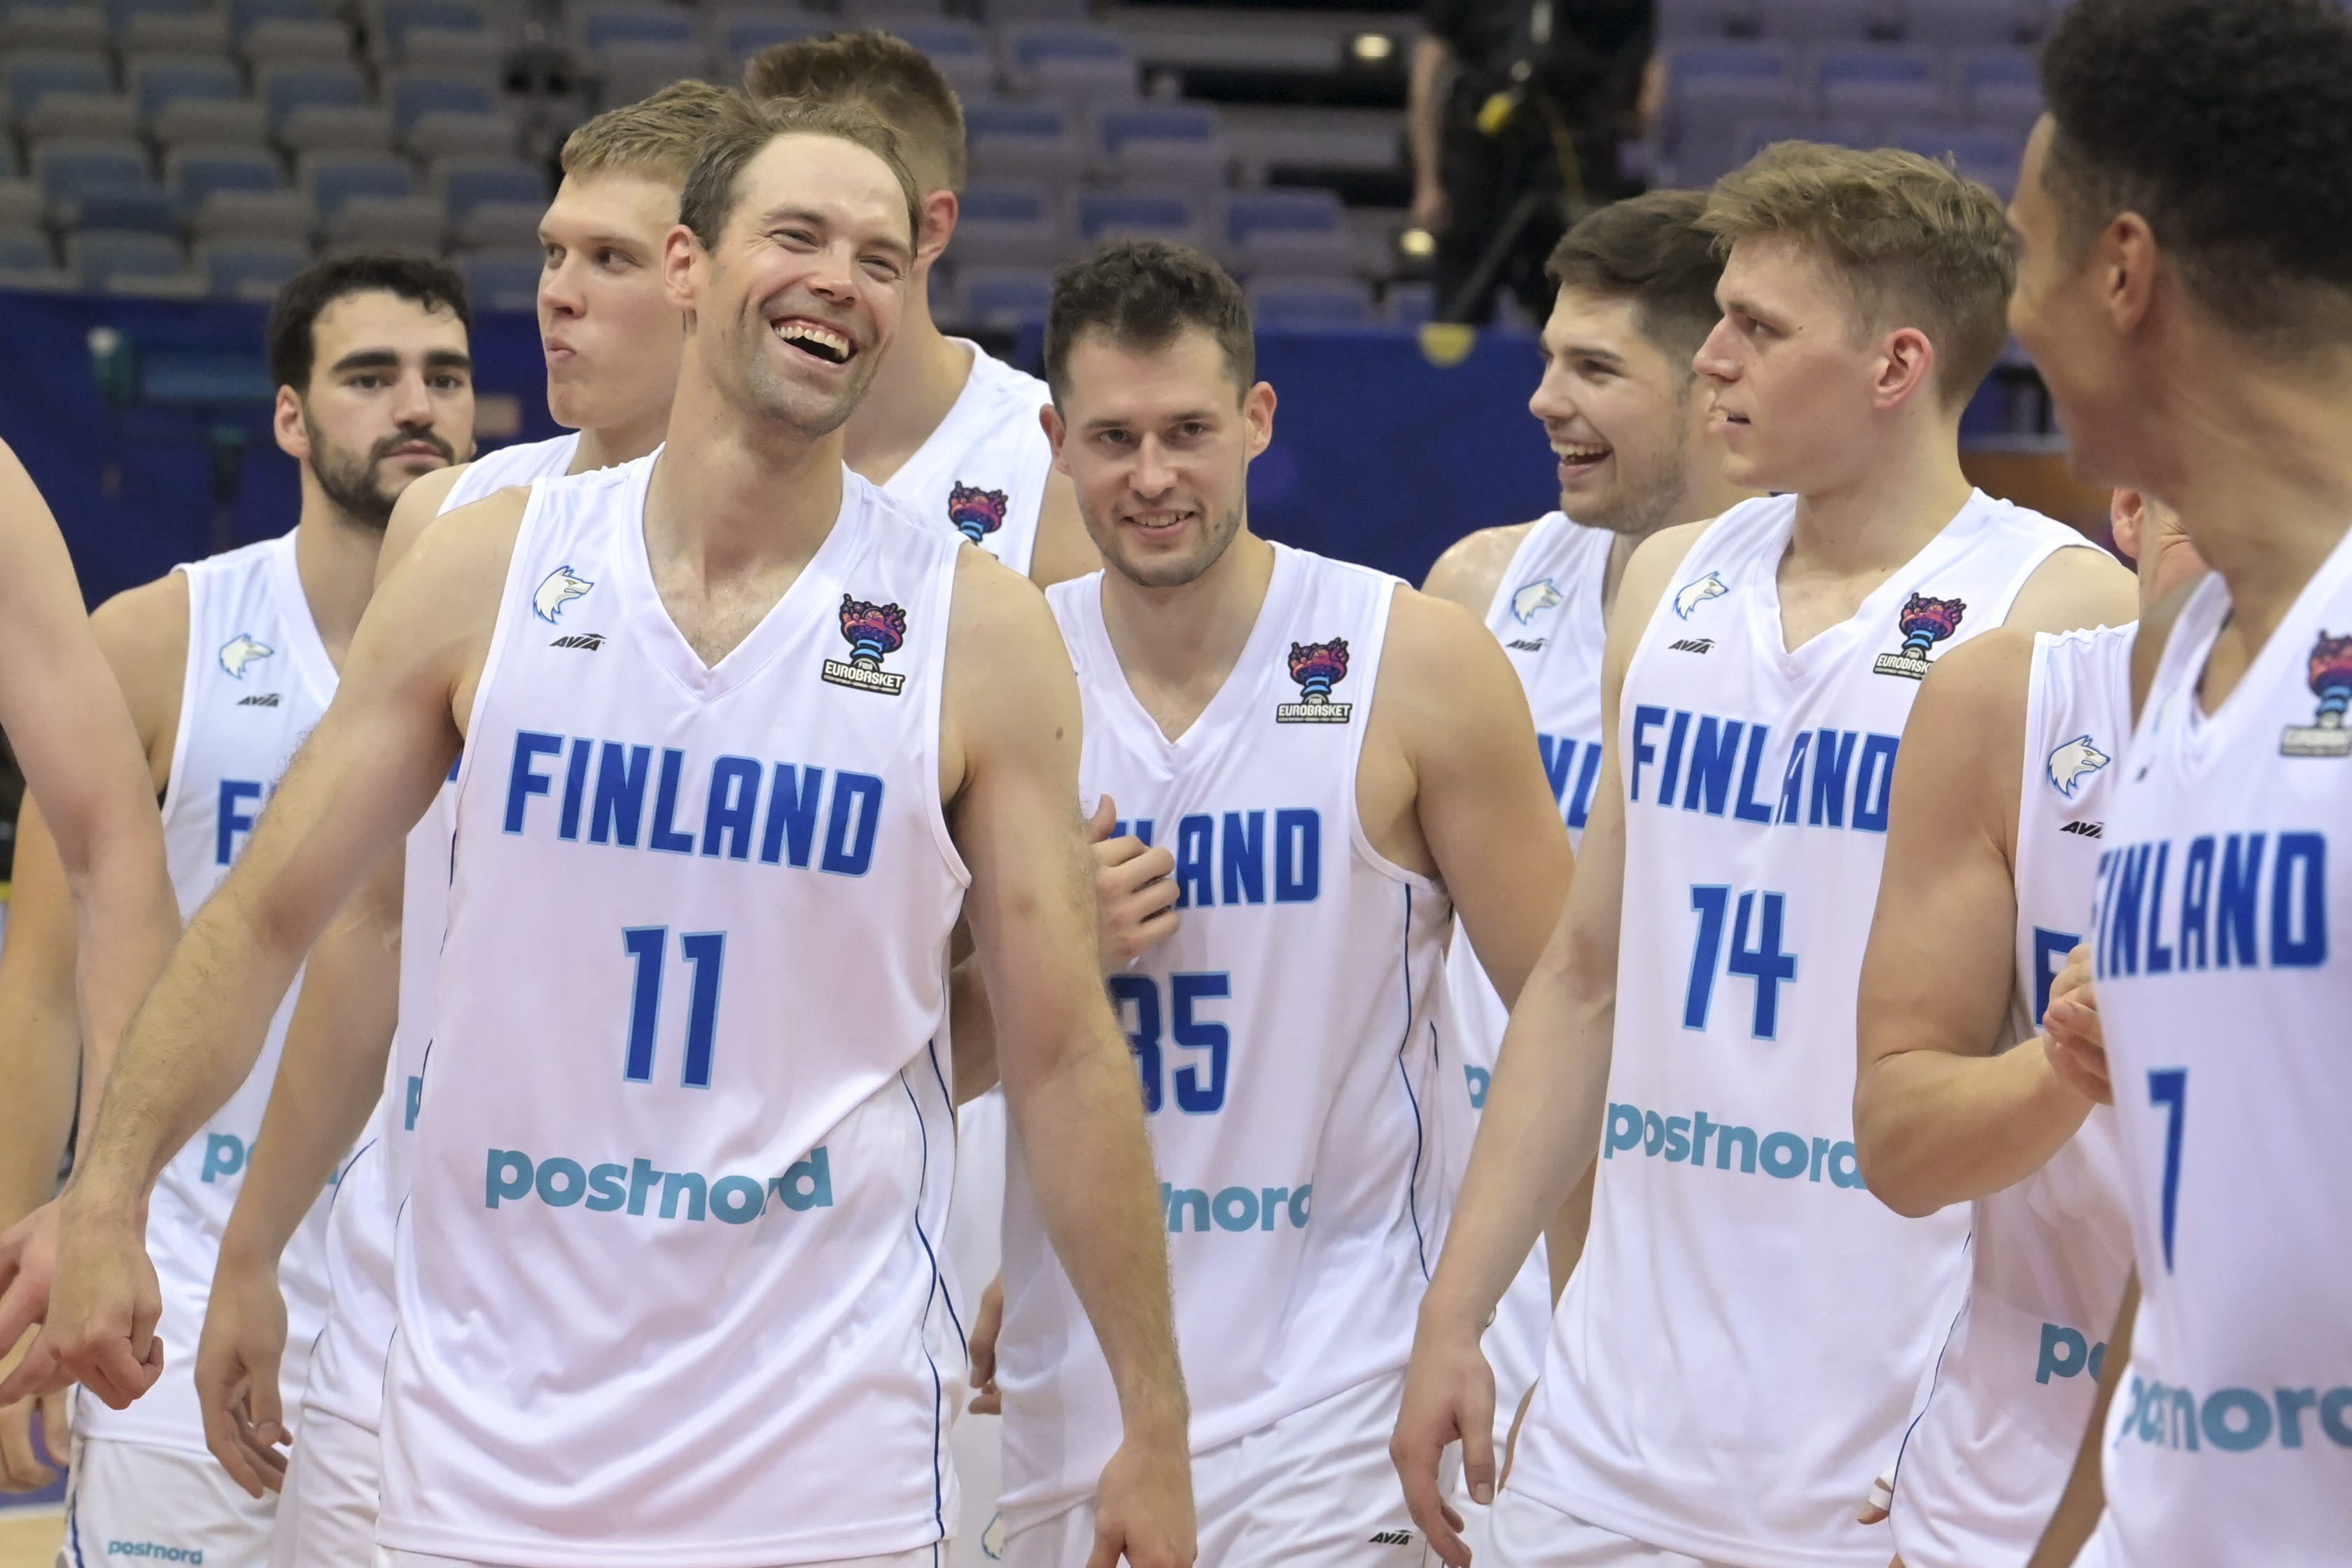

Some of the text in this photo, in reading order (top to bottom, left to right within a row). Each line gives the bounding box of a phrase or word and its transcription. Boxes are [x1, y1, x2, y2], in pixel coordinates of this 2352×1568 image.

[548, 634, 608, 651] AVIA
[1667, 638, 1716, 654] AVIA
[825, 661, 903, 687] EUROBASKET
[858, 662, 873, 671] FIBA
[1877, 654, 1933, 673] EUROBASK
[1278, 705, 1350, 716] EUROBASKET
[1630, 703, 1900, 834] FINLAND
[502, 729, 885, 878] FINLAND
[2059, 820, 2104, 839] AVI
[1682, 883, 1798, 1042] 14
[622, 925, 727, 1089] 11
[1604, 1102, 1868, 1189] postnord
[485, 1146, 834, 1224] postnord
[108, 1540, 203, 1565] postnord
